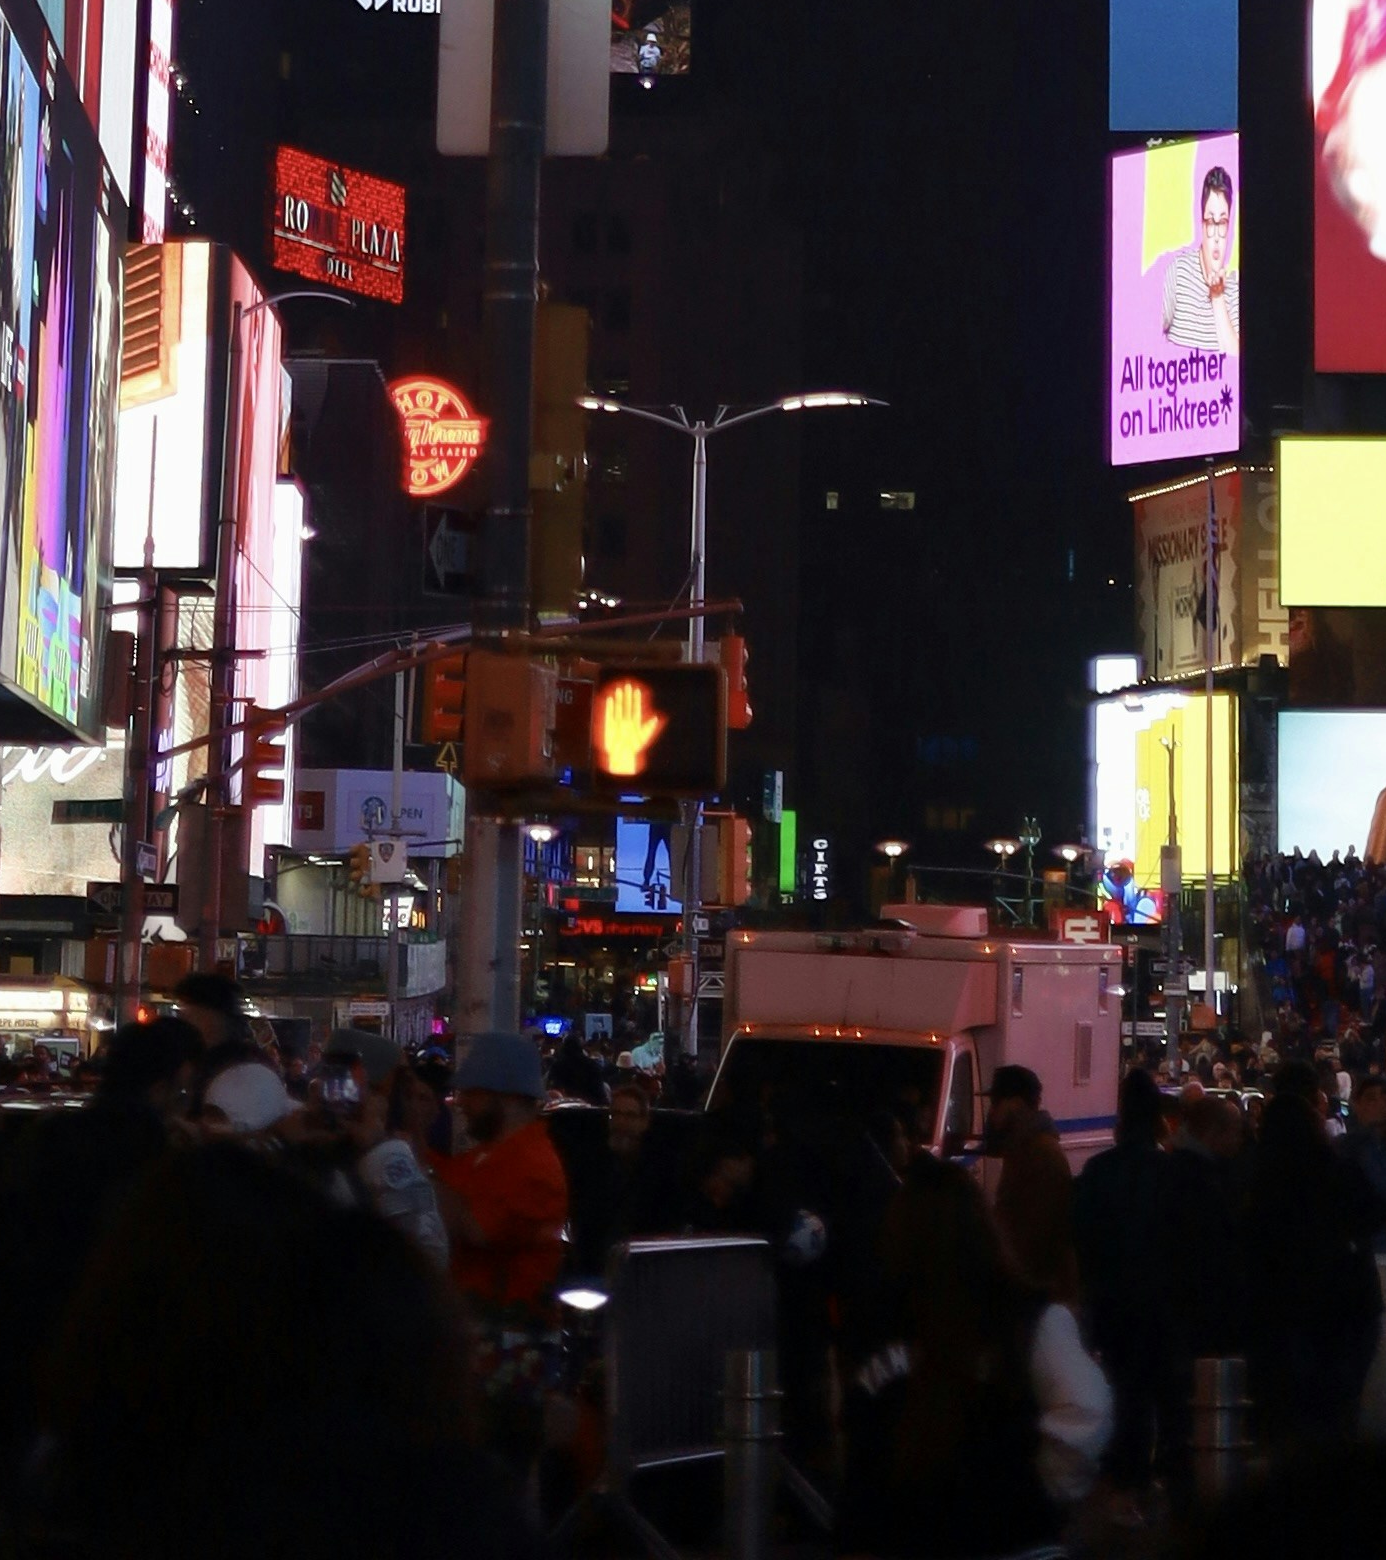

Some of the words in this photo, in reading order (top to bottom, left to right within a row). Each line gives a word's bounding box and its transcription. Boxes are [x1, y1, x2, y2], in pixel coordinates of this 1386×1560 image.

[1119, 355, 1144, 394] All
[1148, 347, 1227, 394] together
[395, 389, 450, 415] HOT
[1119, 406, 1144, 439] on
[1148, 392, 1220, 436] Linktree
[431, 447, 477, 457] GLAZED
[410, 459, 450, 486] OW
[390, 807, 423, 820] PEN
[812, 838, 829, 901] GIFTS
[100, 890, 122, 906] ON
[146, 891, 169, 907] AY
